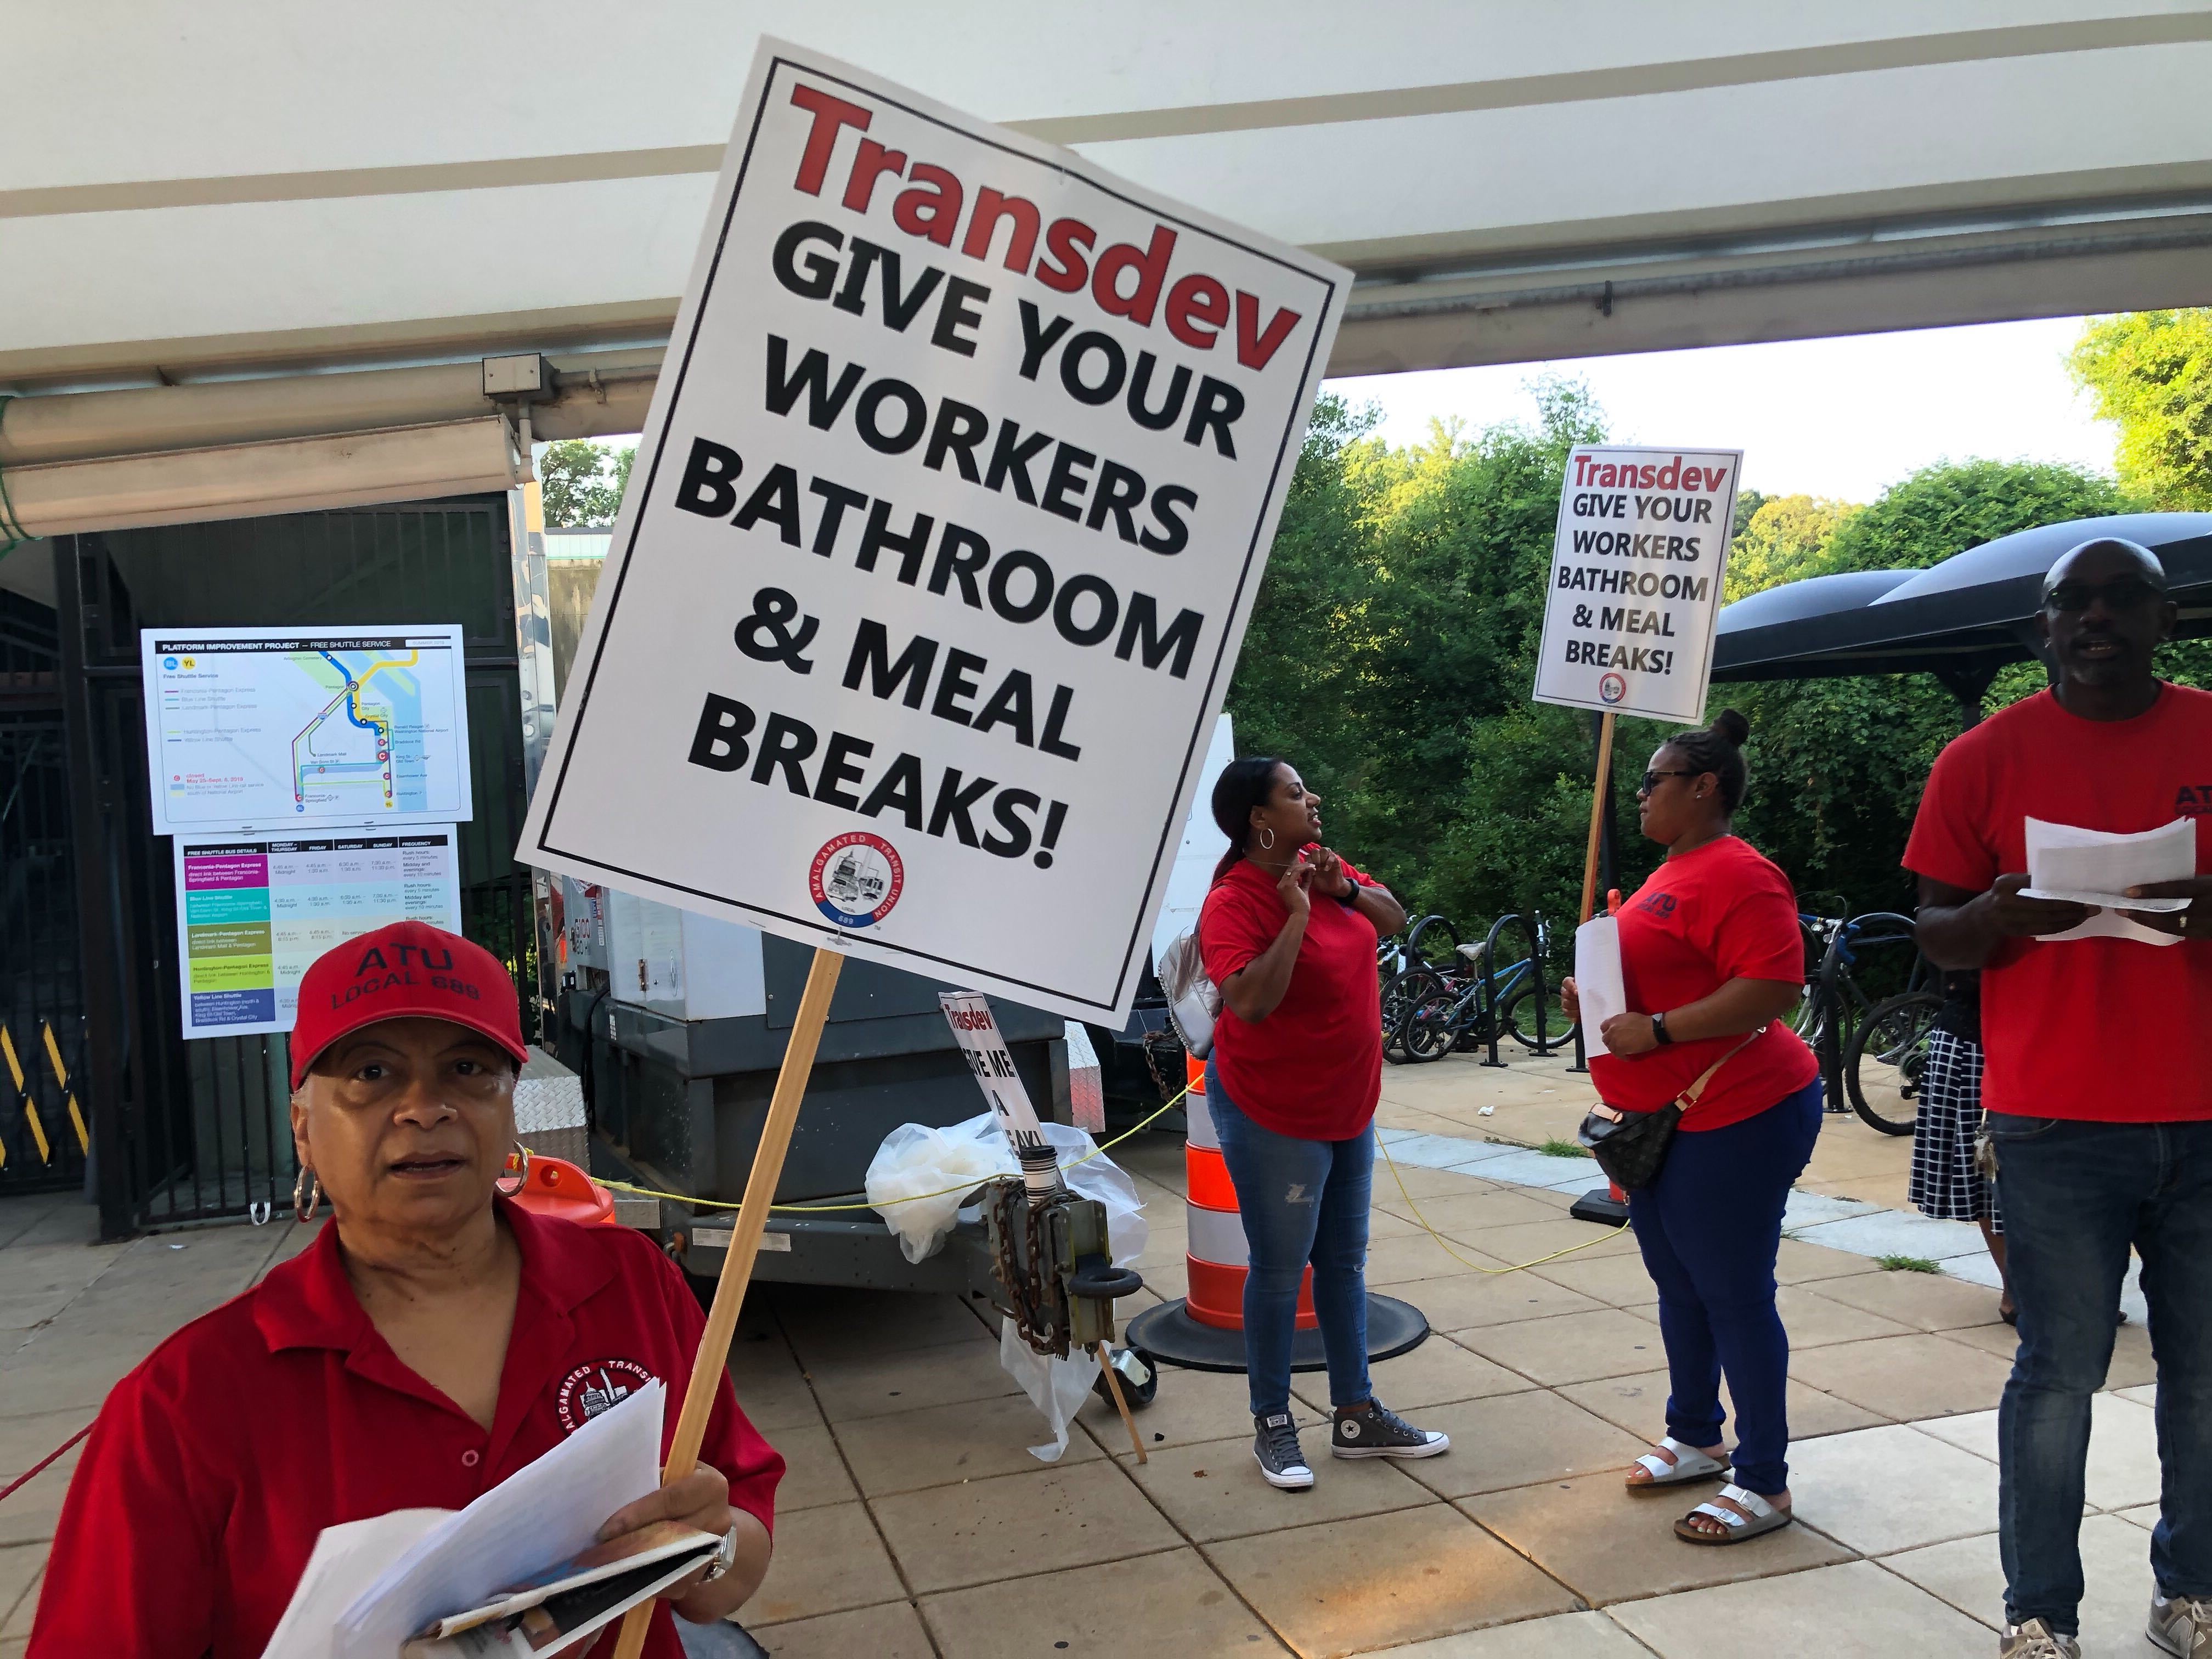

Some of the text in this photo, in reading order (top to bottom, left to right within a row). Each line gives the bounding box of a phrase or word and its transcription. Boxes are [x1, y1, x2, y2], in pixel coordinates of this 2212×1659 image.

[790, 82, 1302, 372] Transdev
[772, 221, 1246, 461] GIVE YOUR
[764, 332, 1199, 556] WORKERS
[1575, 455, 1727, 492] Transdev
[1573, 494, 1712, 523] GIVE YOUR
[675, 436, 1205, 680] BATHROOM
[1573, 529, 1701, 562] WORKERS
[1558, 566, 1709, 601] BATHROOM
[1572, 604, 1675, 637] & MEAL
[733, 586, 1082, 761] & MEAL
[1565, 640, 1673, 675] BREAKS!
[687, 691, 1069, 870] BREAKS!
[2175, 785, 2212, 804] AT
[812, 835, 901, 918] AMALGAMATED TRANSIT UNION
[838, 915, 854, 924] 689
[355, 943, 453, 977] ATU
[331, 970, 480, 1009] LOCAL 689
[986, 1050, 1016, 1078] ME
[992, 1090, 1009, 1116] A
[559, 1361, 652, 1430] ALGAMATED TRANSI
